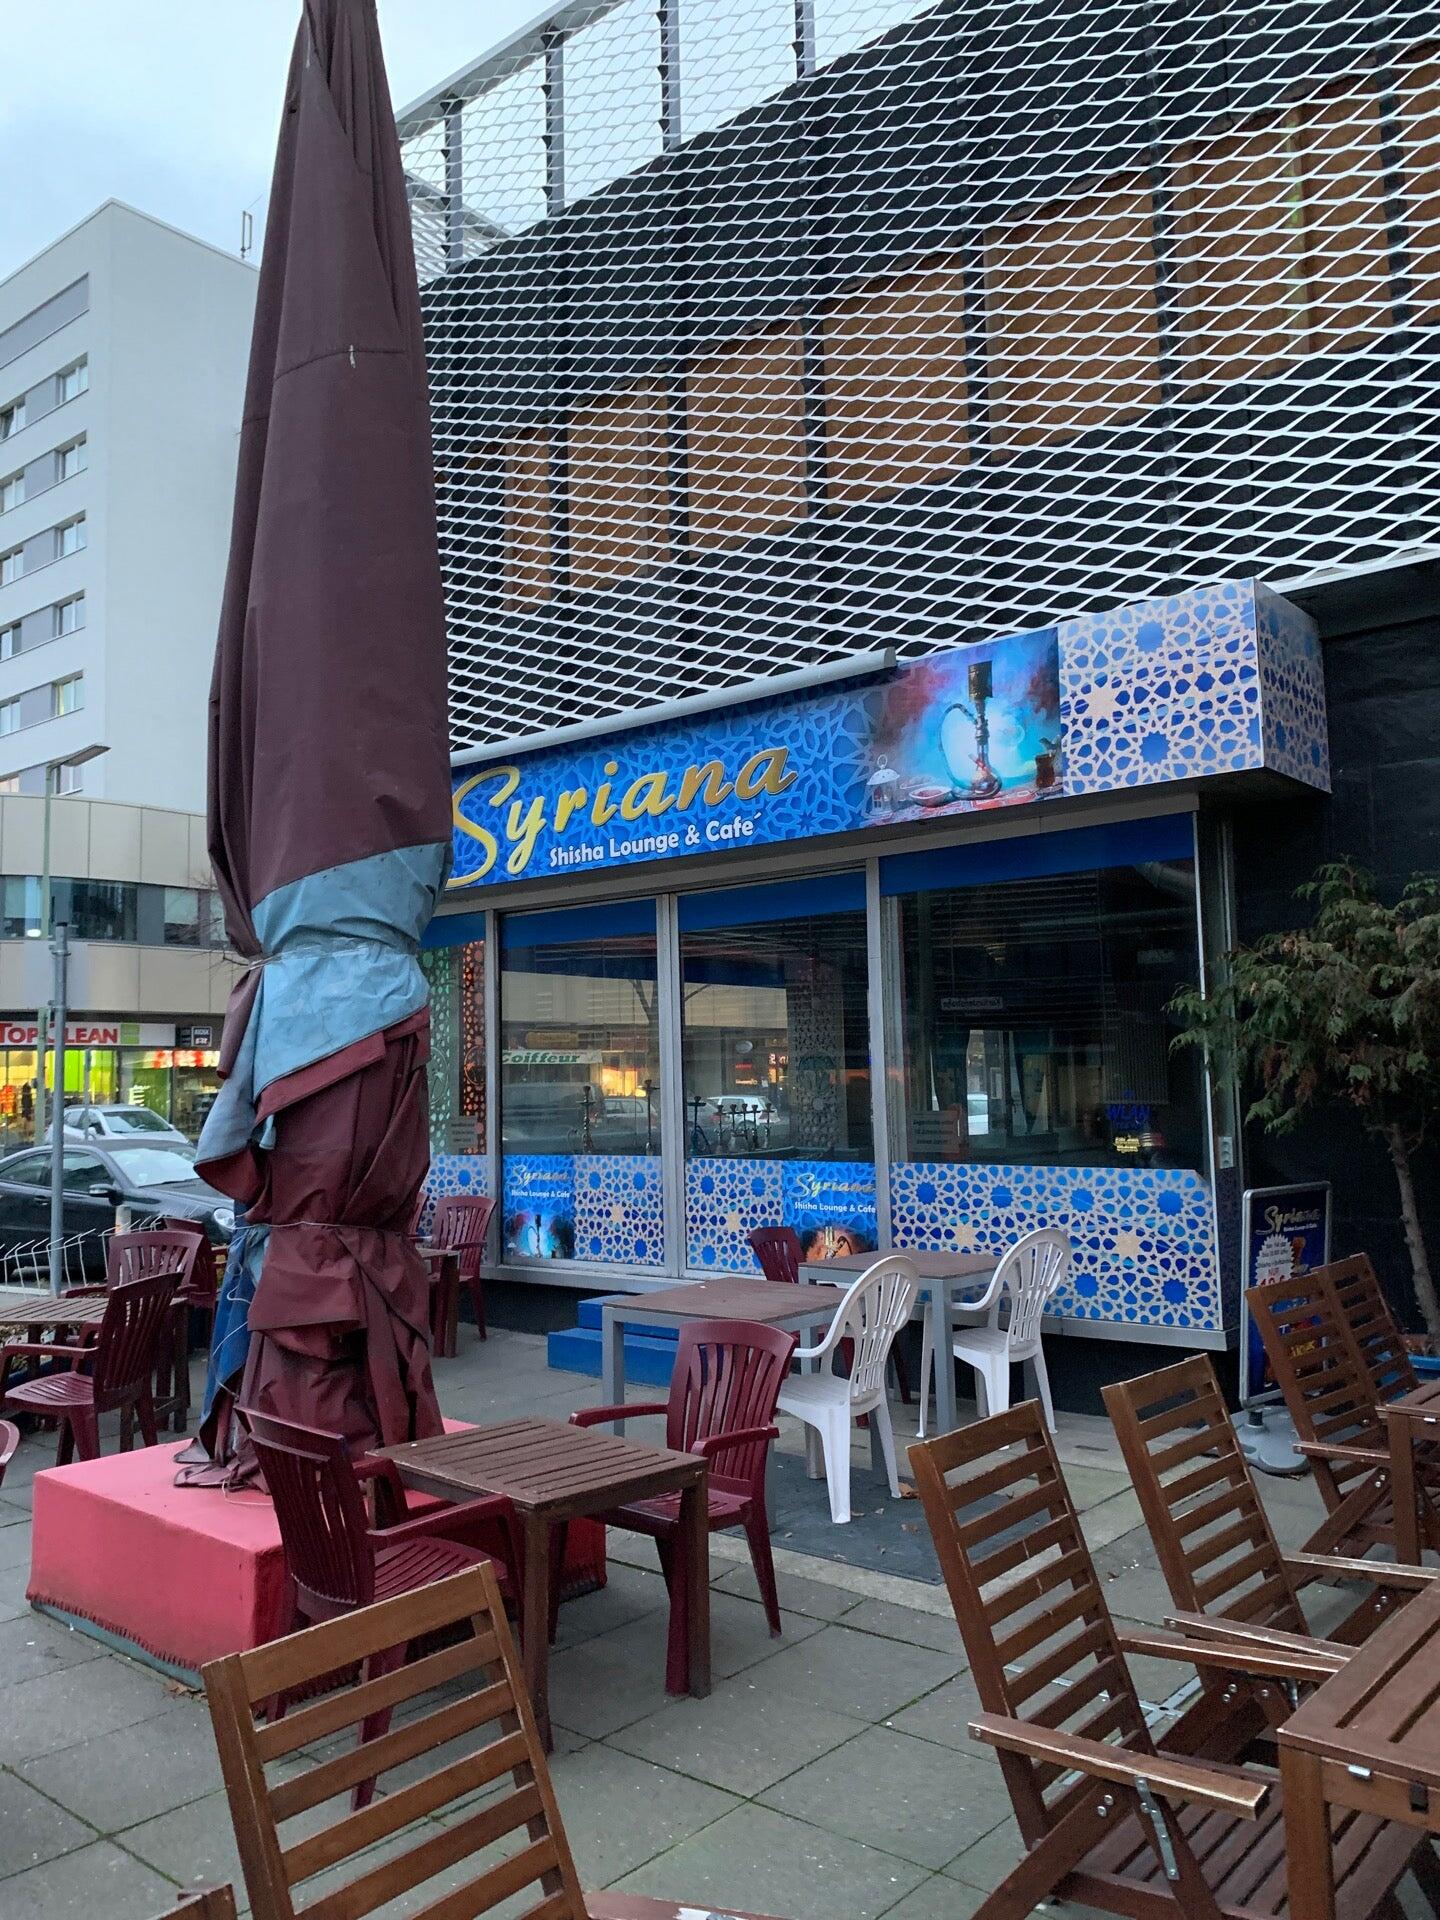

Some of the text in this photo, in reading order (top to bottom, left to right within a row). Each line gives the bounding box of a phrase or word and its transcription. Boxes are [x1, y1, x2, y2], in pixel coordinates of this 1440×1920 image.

[445, 746, 800, 889] Syriana
[549, 842, 604, 868] Shisha
[609, 832, 680, 858] Lounge
[685, 824, 700, 846] &
[787, 1172, 876, 1198] Syriana
[794, 1201, 818, 1210] Shisha
[819, 1202, 847, 1212] Lounge
[849, 1204, 856, 1213] &
